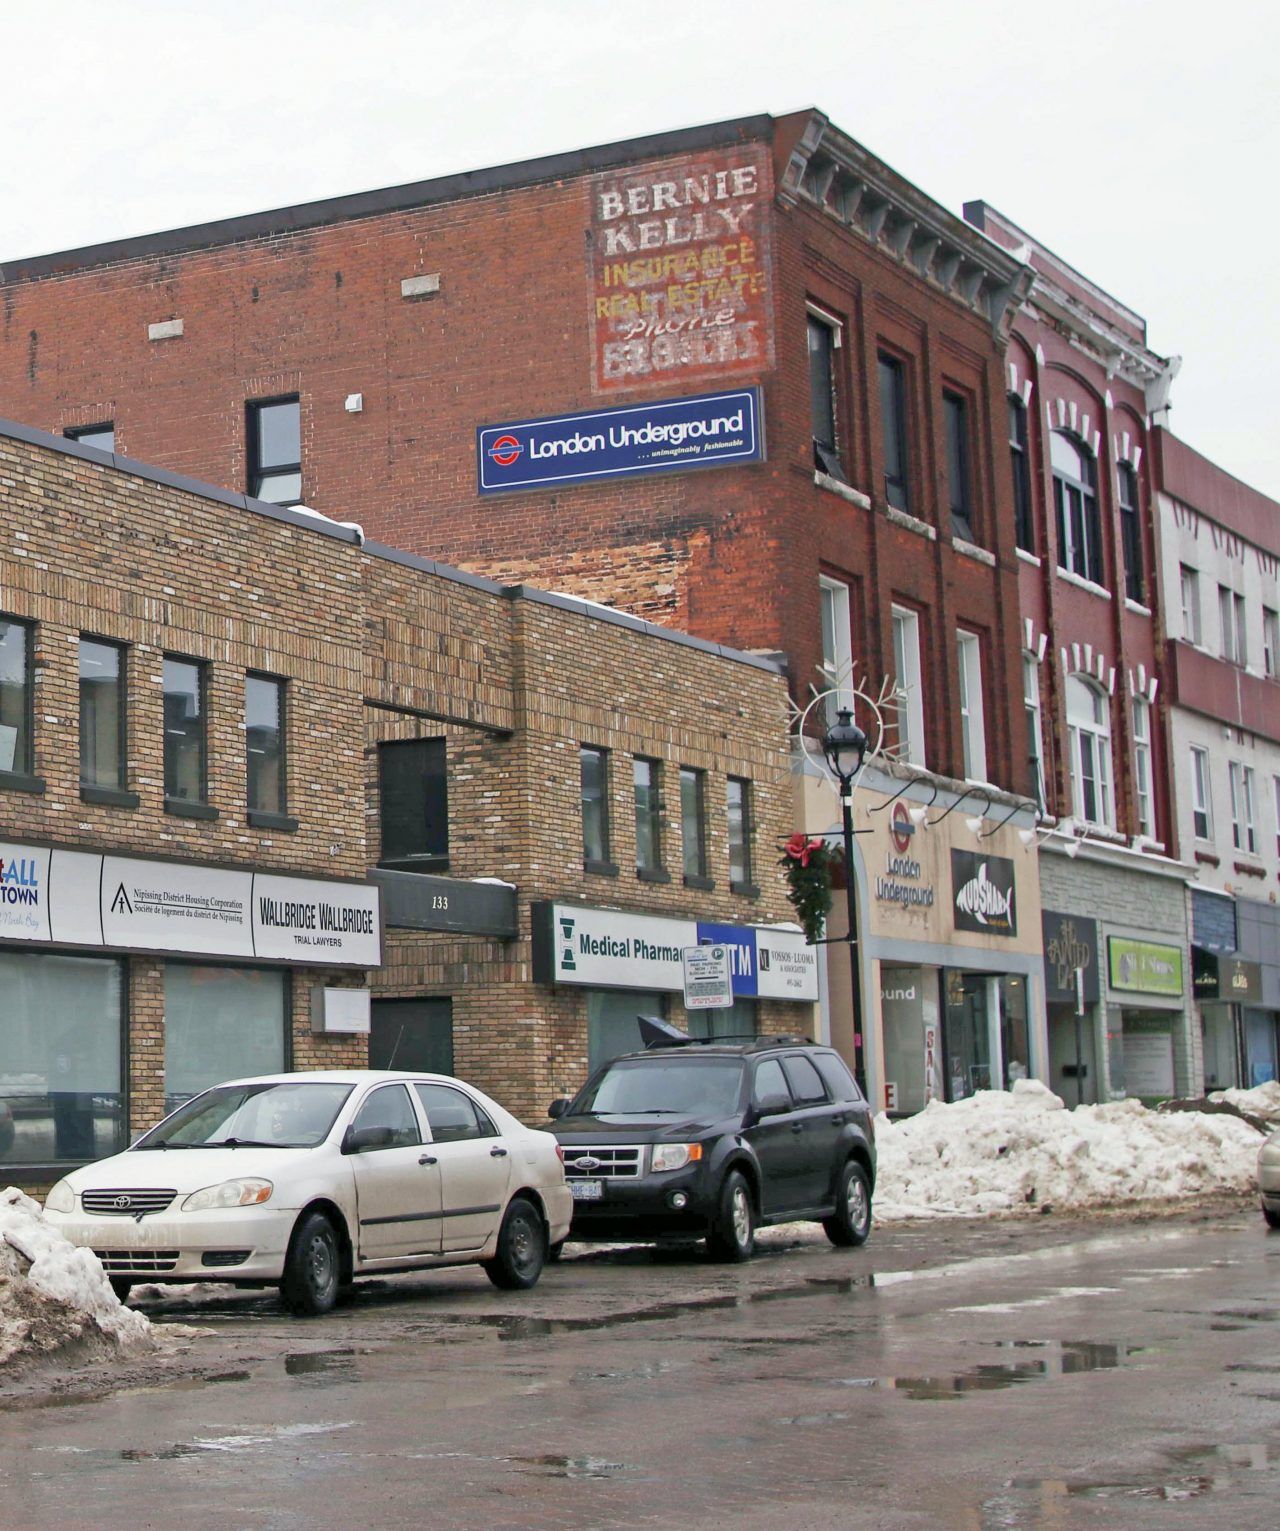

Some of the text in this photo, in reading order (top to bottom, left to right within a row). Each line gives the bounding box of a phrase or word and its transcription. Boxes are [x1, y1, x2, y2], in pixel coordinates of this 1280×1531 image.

[599, 165, 757, 220] BERNIE
[604, 203, 754, 256] KELLY
[603, 241, 755, 287] INSURANCE
[595, 290, 652, 318] REAL
[530, 410, 743, 459] London Underground
[704, 439, 743, 452] fashionable
[886, 852, 920, 880] London
[134, 888, 242, 910] Nipissing District Housing Corporation
[432, 896, 448, 910] 133
[875, 877, 934, 907] Underground
[956, 863, 1012, 928] MUDSHARK
[154, 906, 160, 914] de
[162, 907, 185, 918] logement
[194, 909, 211, 920] district
[212, 911, 218, 920] de
[219, 913, 242, 924] Nipissing
[260, 897, 373, 934] WALLBRIDGE WALLBRIDGE
[294, 936, 342, 947] TRIAL LAWYERS
[580, 934, 684, 962] Medical Pharma
